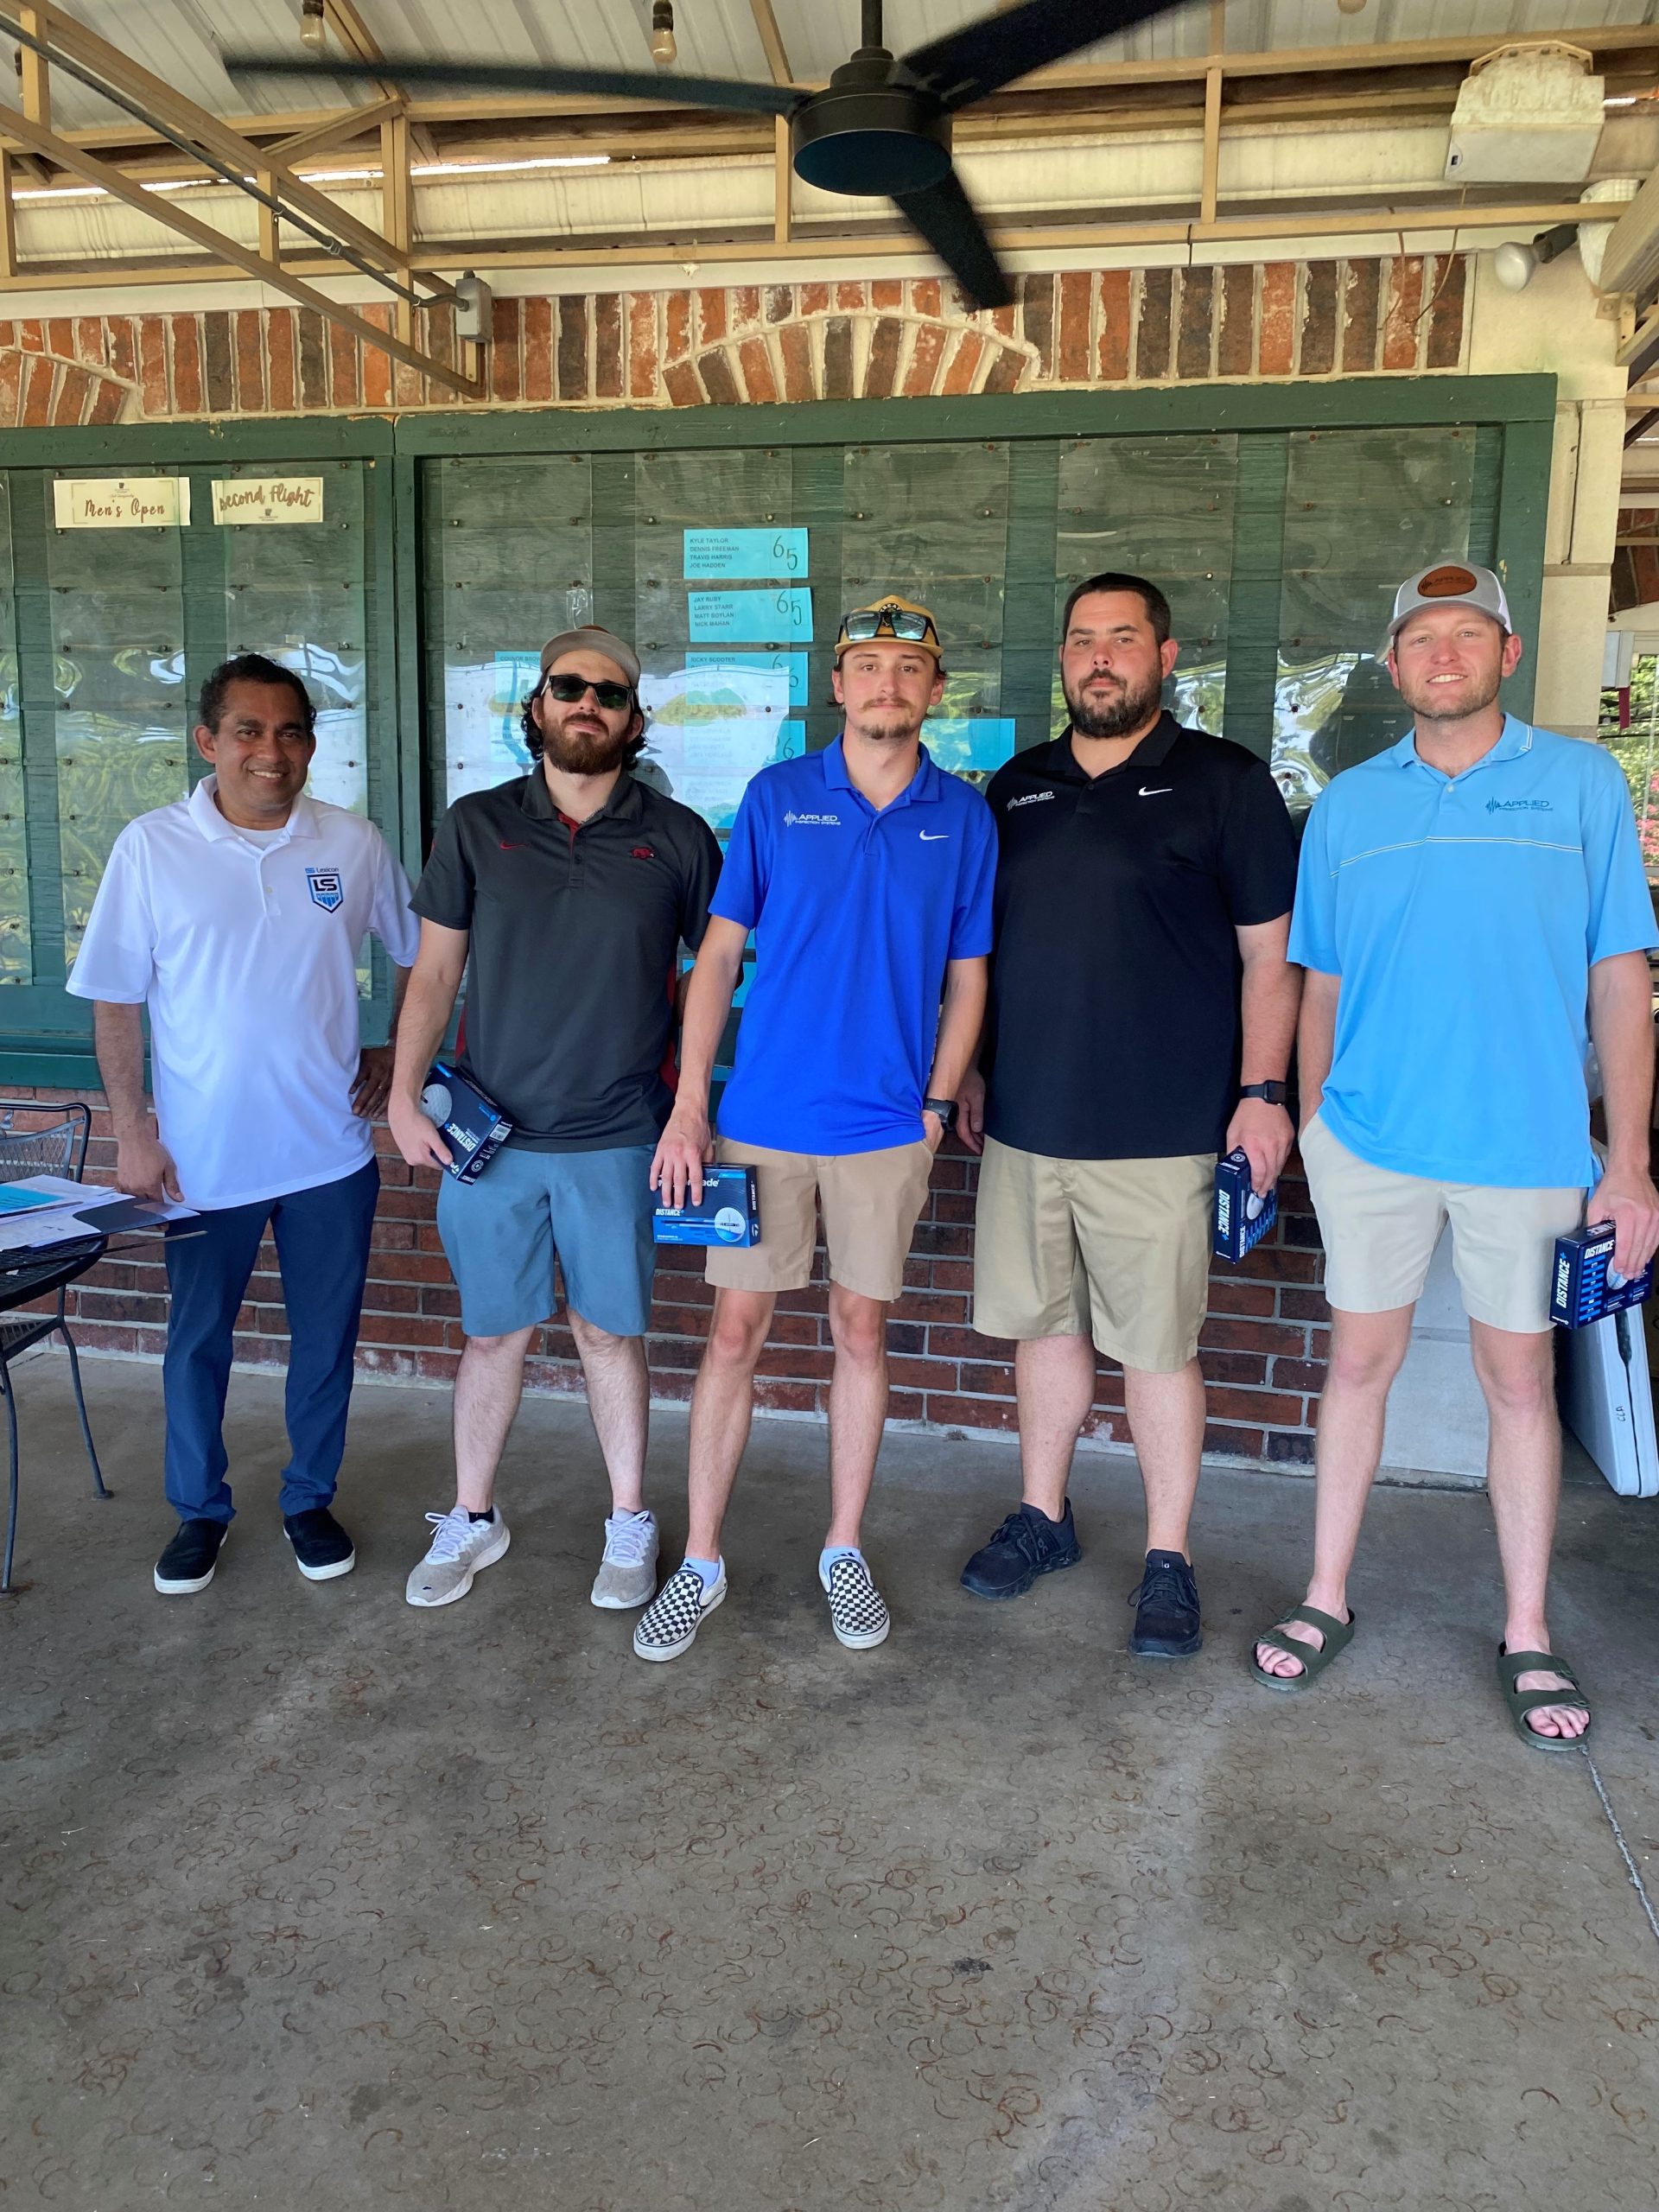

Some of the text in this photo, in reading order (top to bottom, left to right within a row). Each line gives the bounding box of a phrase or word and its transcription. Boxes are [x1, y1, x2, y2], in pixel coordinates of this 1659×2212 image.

[85, 498, 164, 523] Men's Open
[1019, 791, 1053, 803] APPLIED
[313, 878, 338, 892] LS
